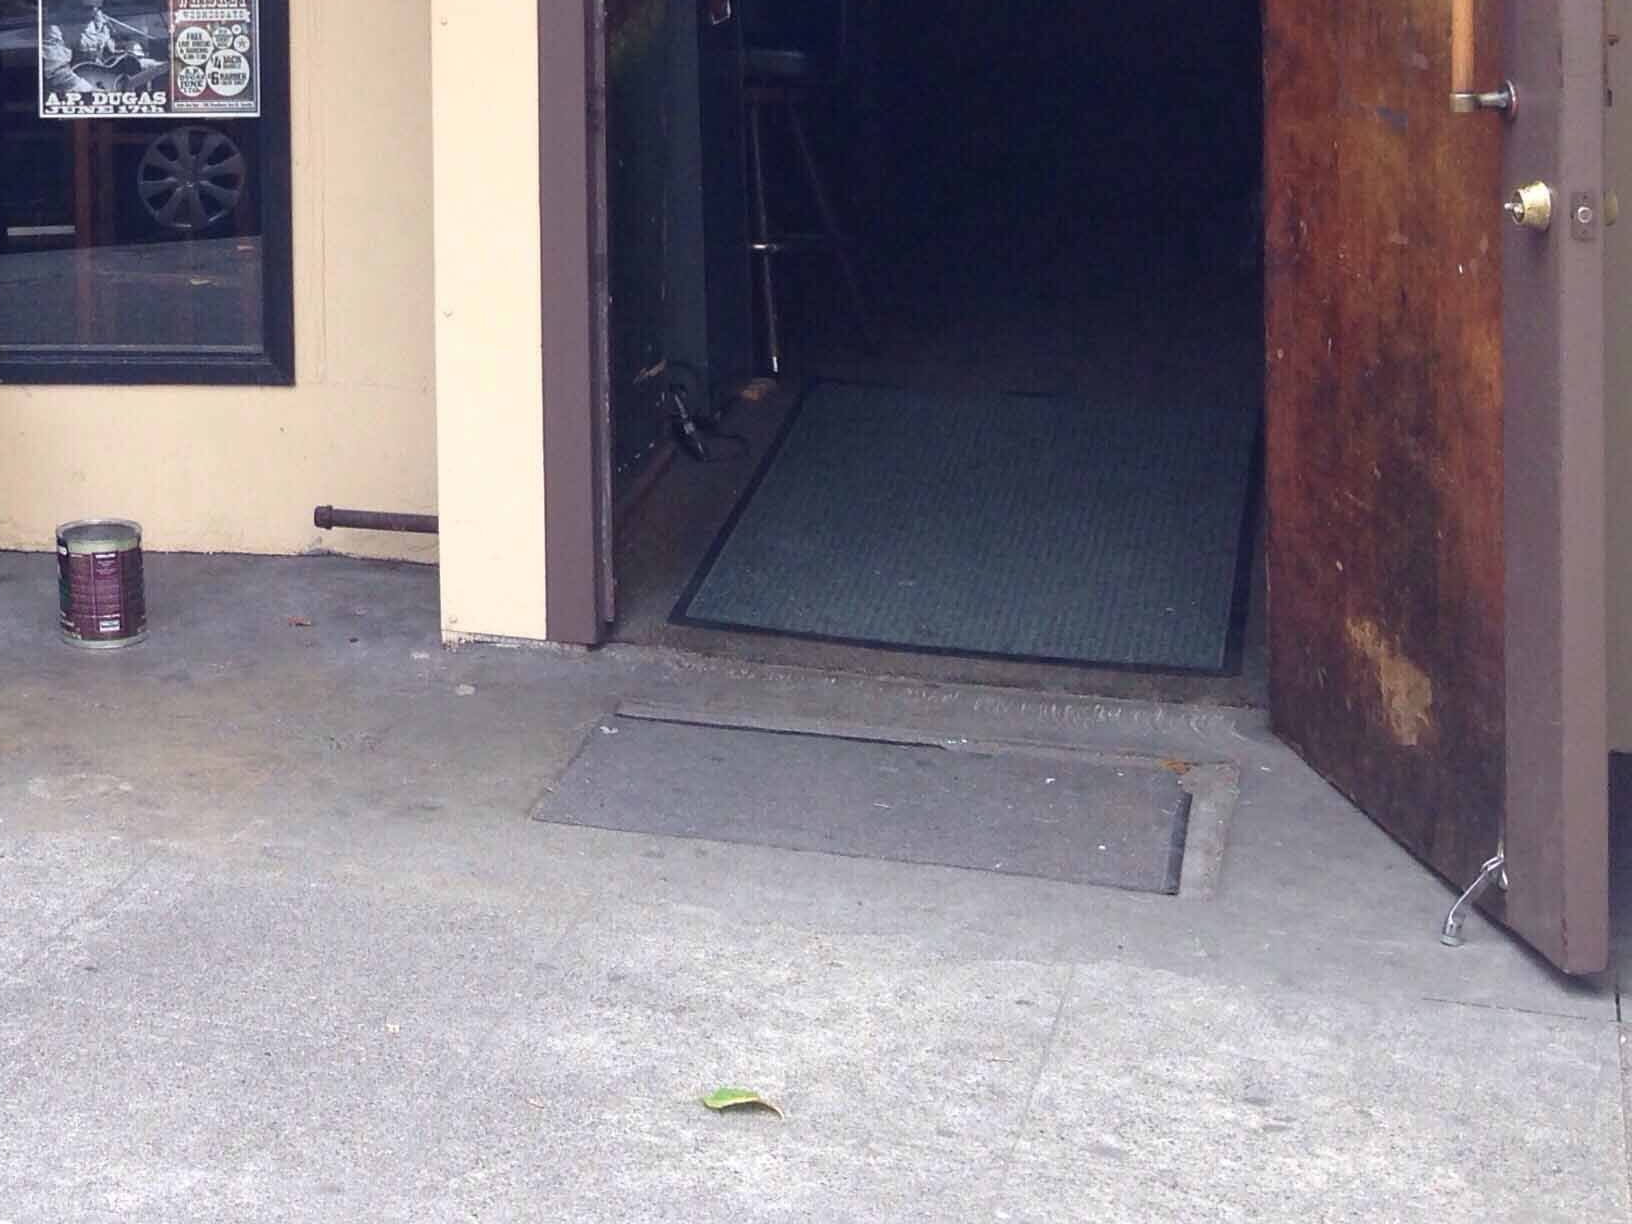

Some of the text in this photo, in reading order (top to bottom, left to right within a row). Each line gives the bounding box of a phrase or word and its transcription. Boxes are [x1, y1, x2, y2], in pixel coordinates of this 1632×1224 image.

[45, 93, 84, 105] A.P.
[92, 92, 166, 105] DUGAS
[45, 106, 114, 114] JUNE
